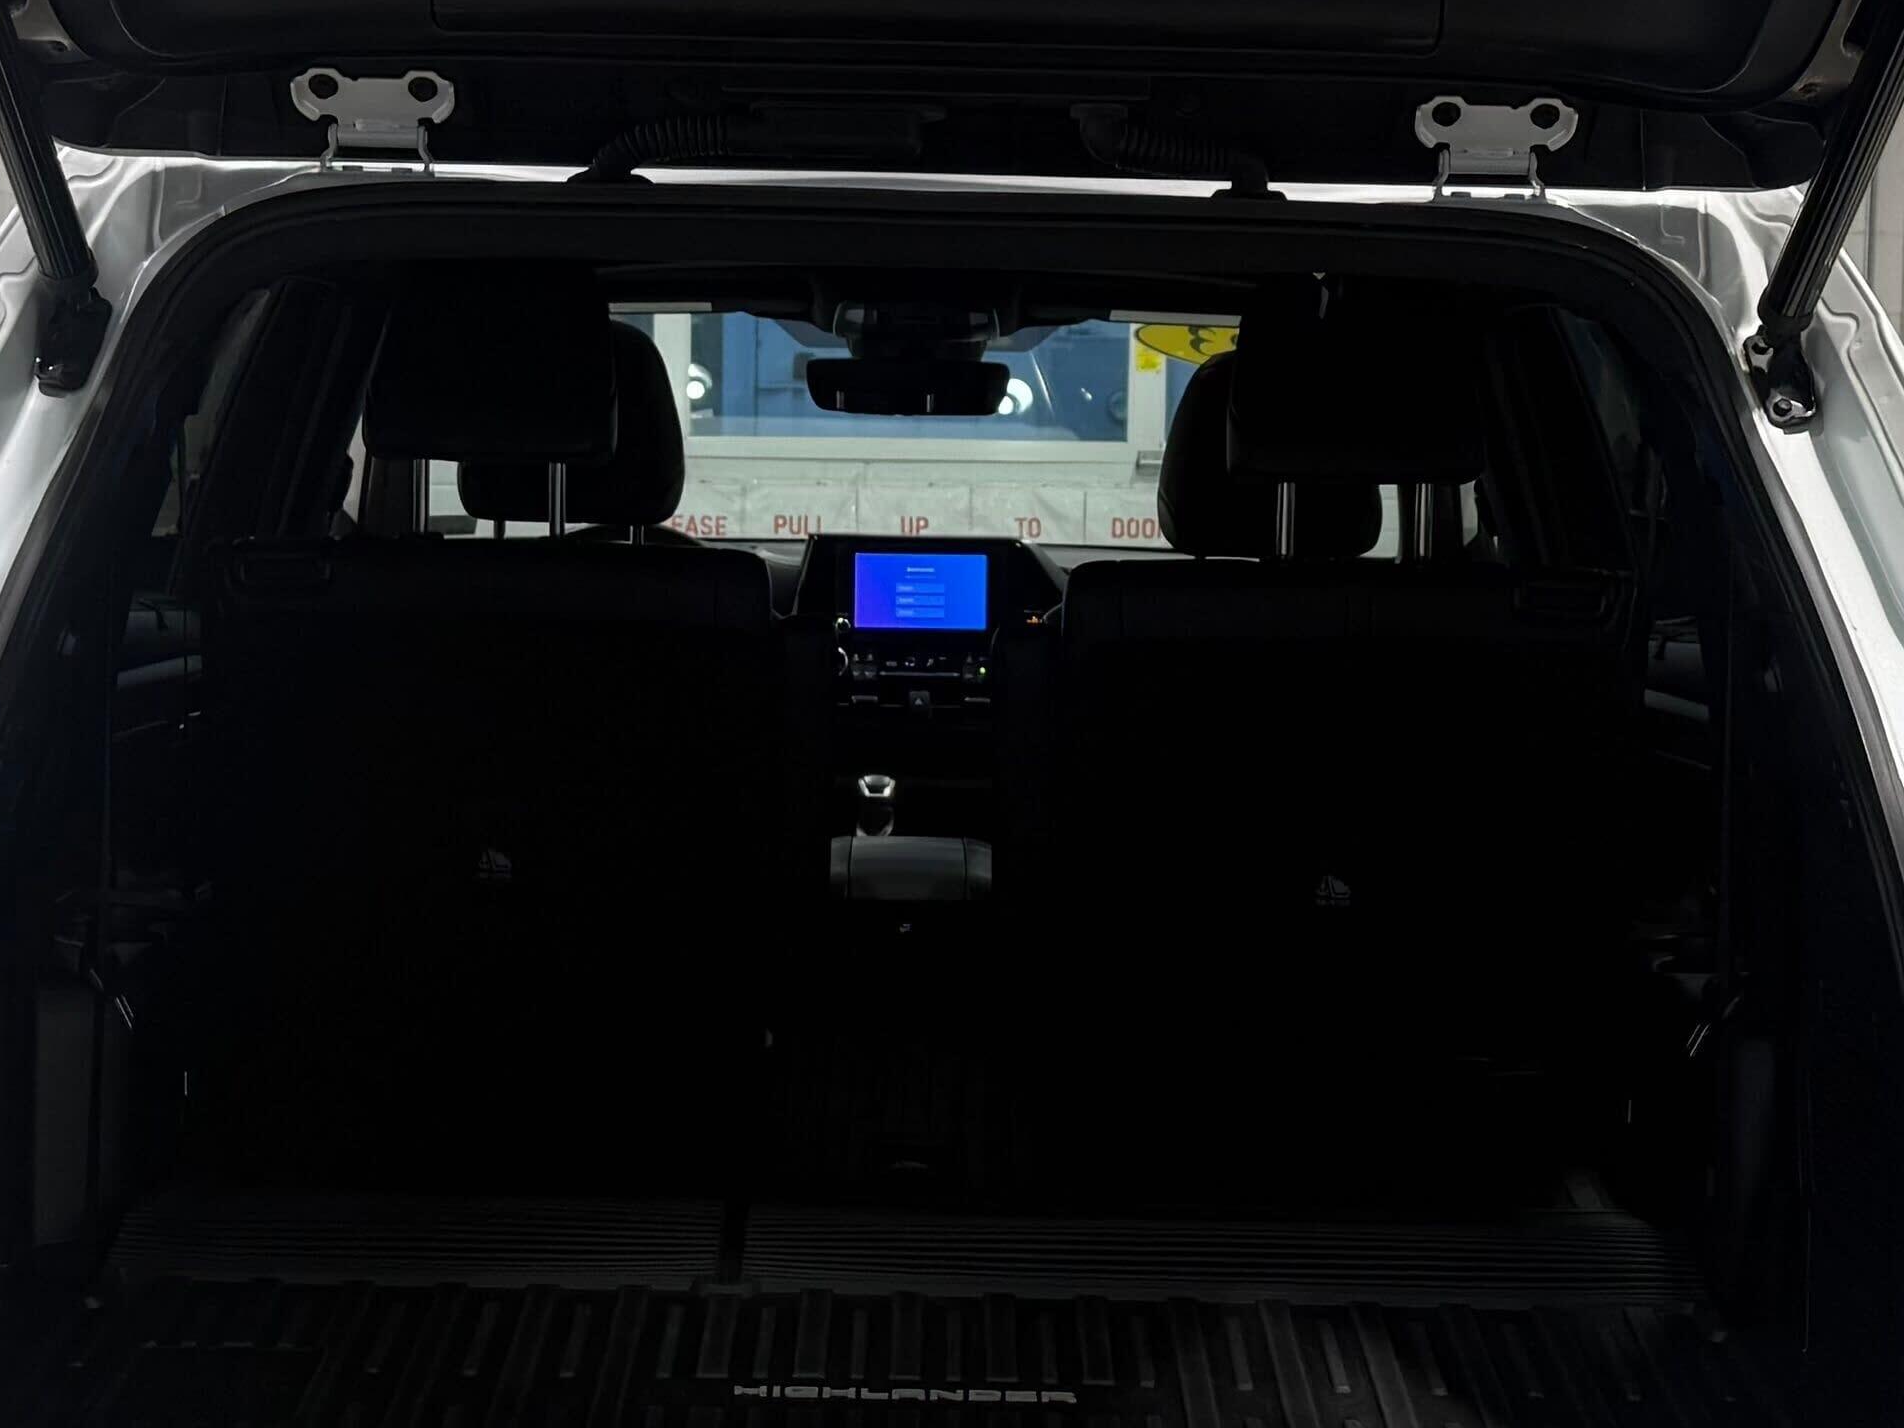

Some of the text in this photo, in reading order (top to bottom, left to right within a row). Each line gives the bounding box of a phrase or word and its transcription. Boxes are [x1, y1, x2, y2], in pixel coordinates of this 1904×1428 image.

[670, 515, 728, 536] EASE
[900, 515, 930, 536] UP
[1015, 516, 1042, 539] TO
[733, 1384, 1078, 1404] HIGHLANDER
